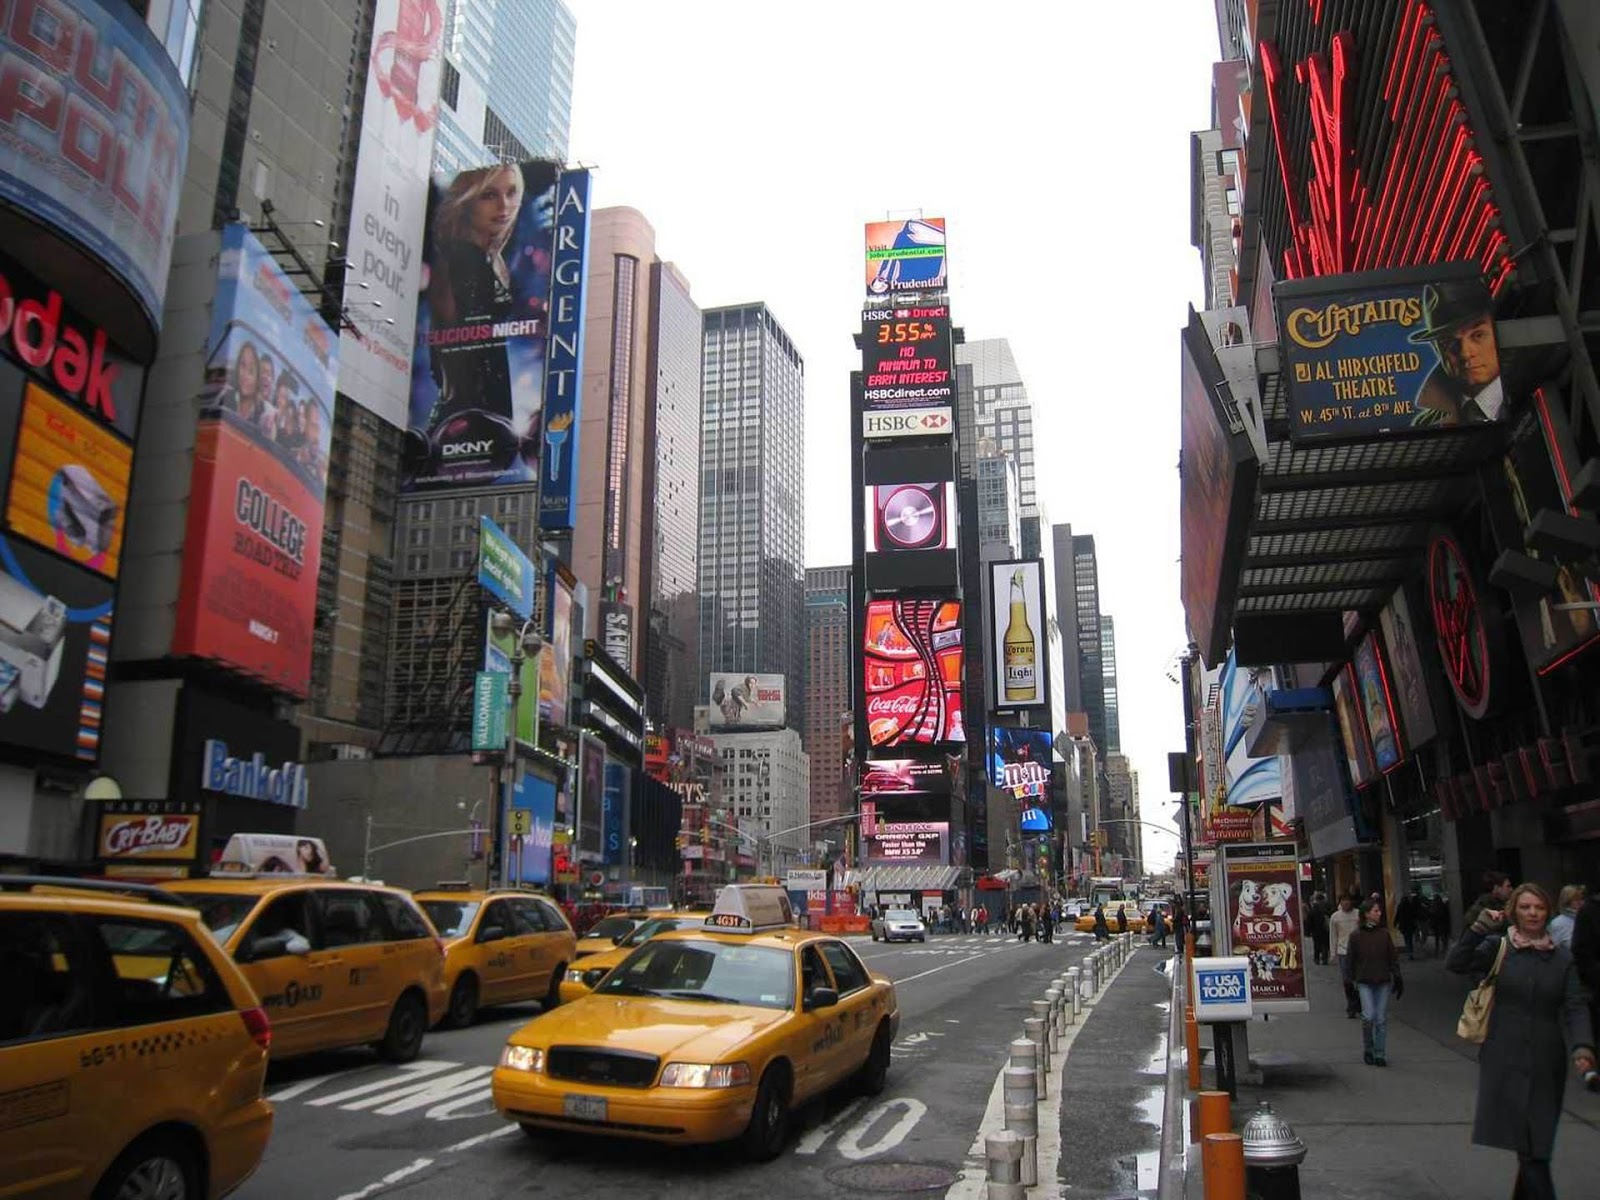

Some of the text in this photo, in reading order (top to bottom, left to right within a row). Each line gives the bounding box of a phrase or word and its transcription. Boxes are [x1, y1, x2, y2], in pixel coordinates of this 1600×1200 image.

[383, 186, 400, 220] in
[364, 216, 412, 270] every
[362, 251, 405, 300] pour.
[890, 277, 944, 290] Prudential
[549, 186, 585, 396] ARGENT
[863, 310, 893, 321] HSBC
[420, 319, 539, 346] ELICIOUS NIGHT
[899, 346, 915, 357] NO
[879, 359, 937, 372] MINIMUM TO
[1315, 362, 1334, 380] AL
[1338, 352, 1420, 378] HIRSCHFELD
[868, 371, 948, 386] EARN INTEREST
[864, 388, 950, 400] HSBCdirect.com
[1333, 376, 1396, 400] THEATRE
[1358, 407, 1372, 418] at
[868, 415, 918, 432] HSBC
[442, 439, 494, 456] DKNY
[235, 476, 307, 567] COLLEGE
[1006, 644, 1034, 656] Corona
[1008, 666, 1033, 680] Light
[918, 832, 939, 840] GXP
[901, 840, 915, 848] than
[916, 840, 926, 848] the
[885, 849, 900, 857] BMW
[716, 915, 739, 927] 4G31
[1246, 921, 1284, 934] 101
[1215, 974, 1241, 987] USA
[1202, 986, 1243, 998] TODAY
[1252, 984, 1280, 994] MARCH
